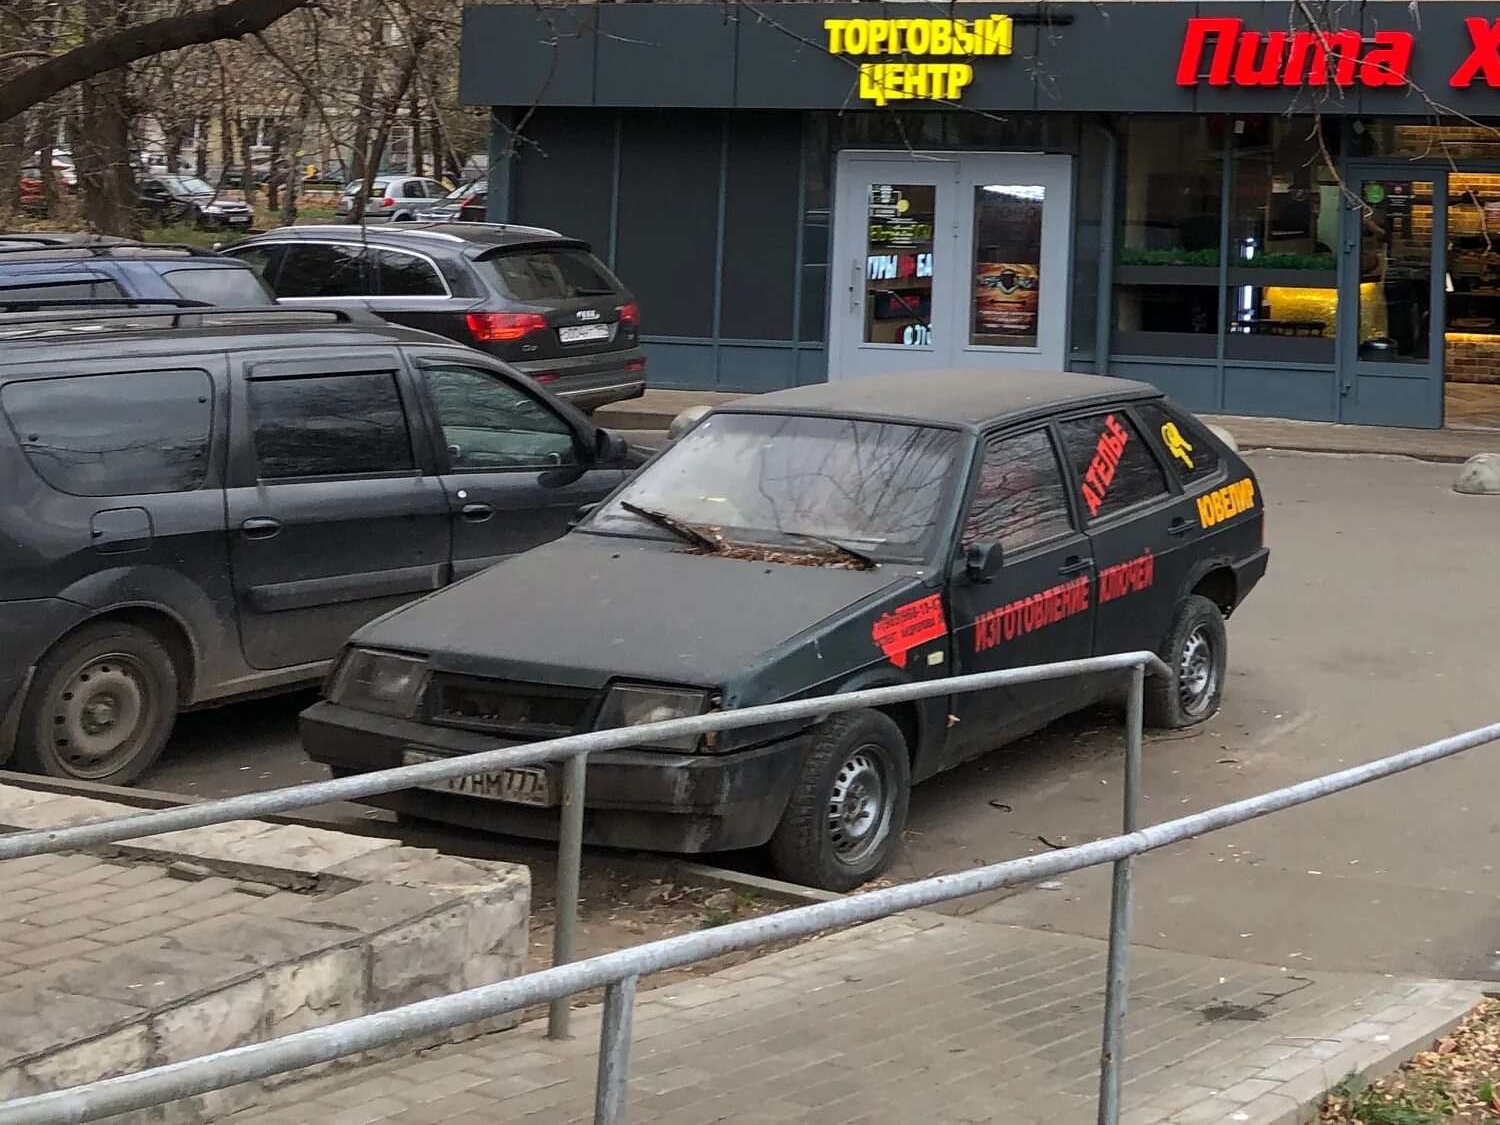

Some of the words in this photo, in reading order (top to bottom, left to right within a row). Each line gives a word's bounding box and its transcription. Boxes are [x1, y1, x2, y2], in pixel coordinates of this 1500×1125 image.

[824, 14, 1013, 55] ТОРГОВЫЙ
[1176, 18, 1414, 87] Пита
[859, 63, 973, 106] ЦЕНТР
[1081, 415, 1129, 516] АТЕЛЬЕ
[1196, 478, 1254, 528] ЮВЕЛИР
[974, 575, 1090, 652] ИЗГОТОВЛЕНИЕ
[1099, 547, 1155, 603] КЛЮЧЕЙ
